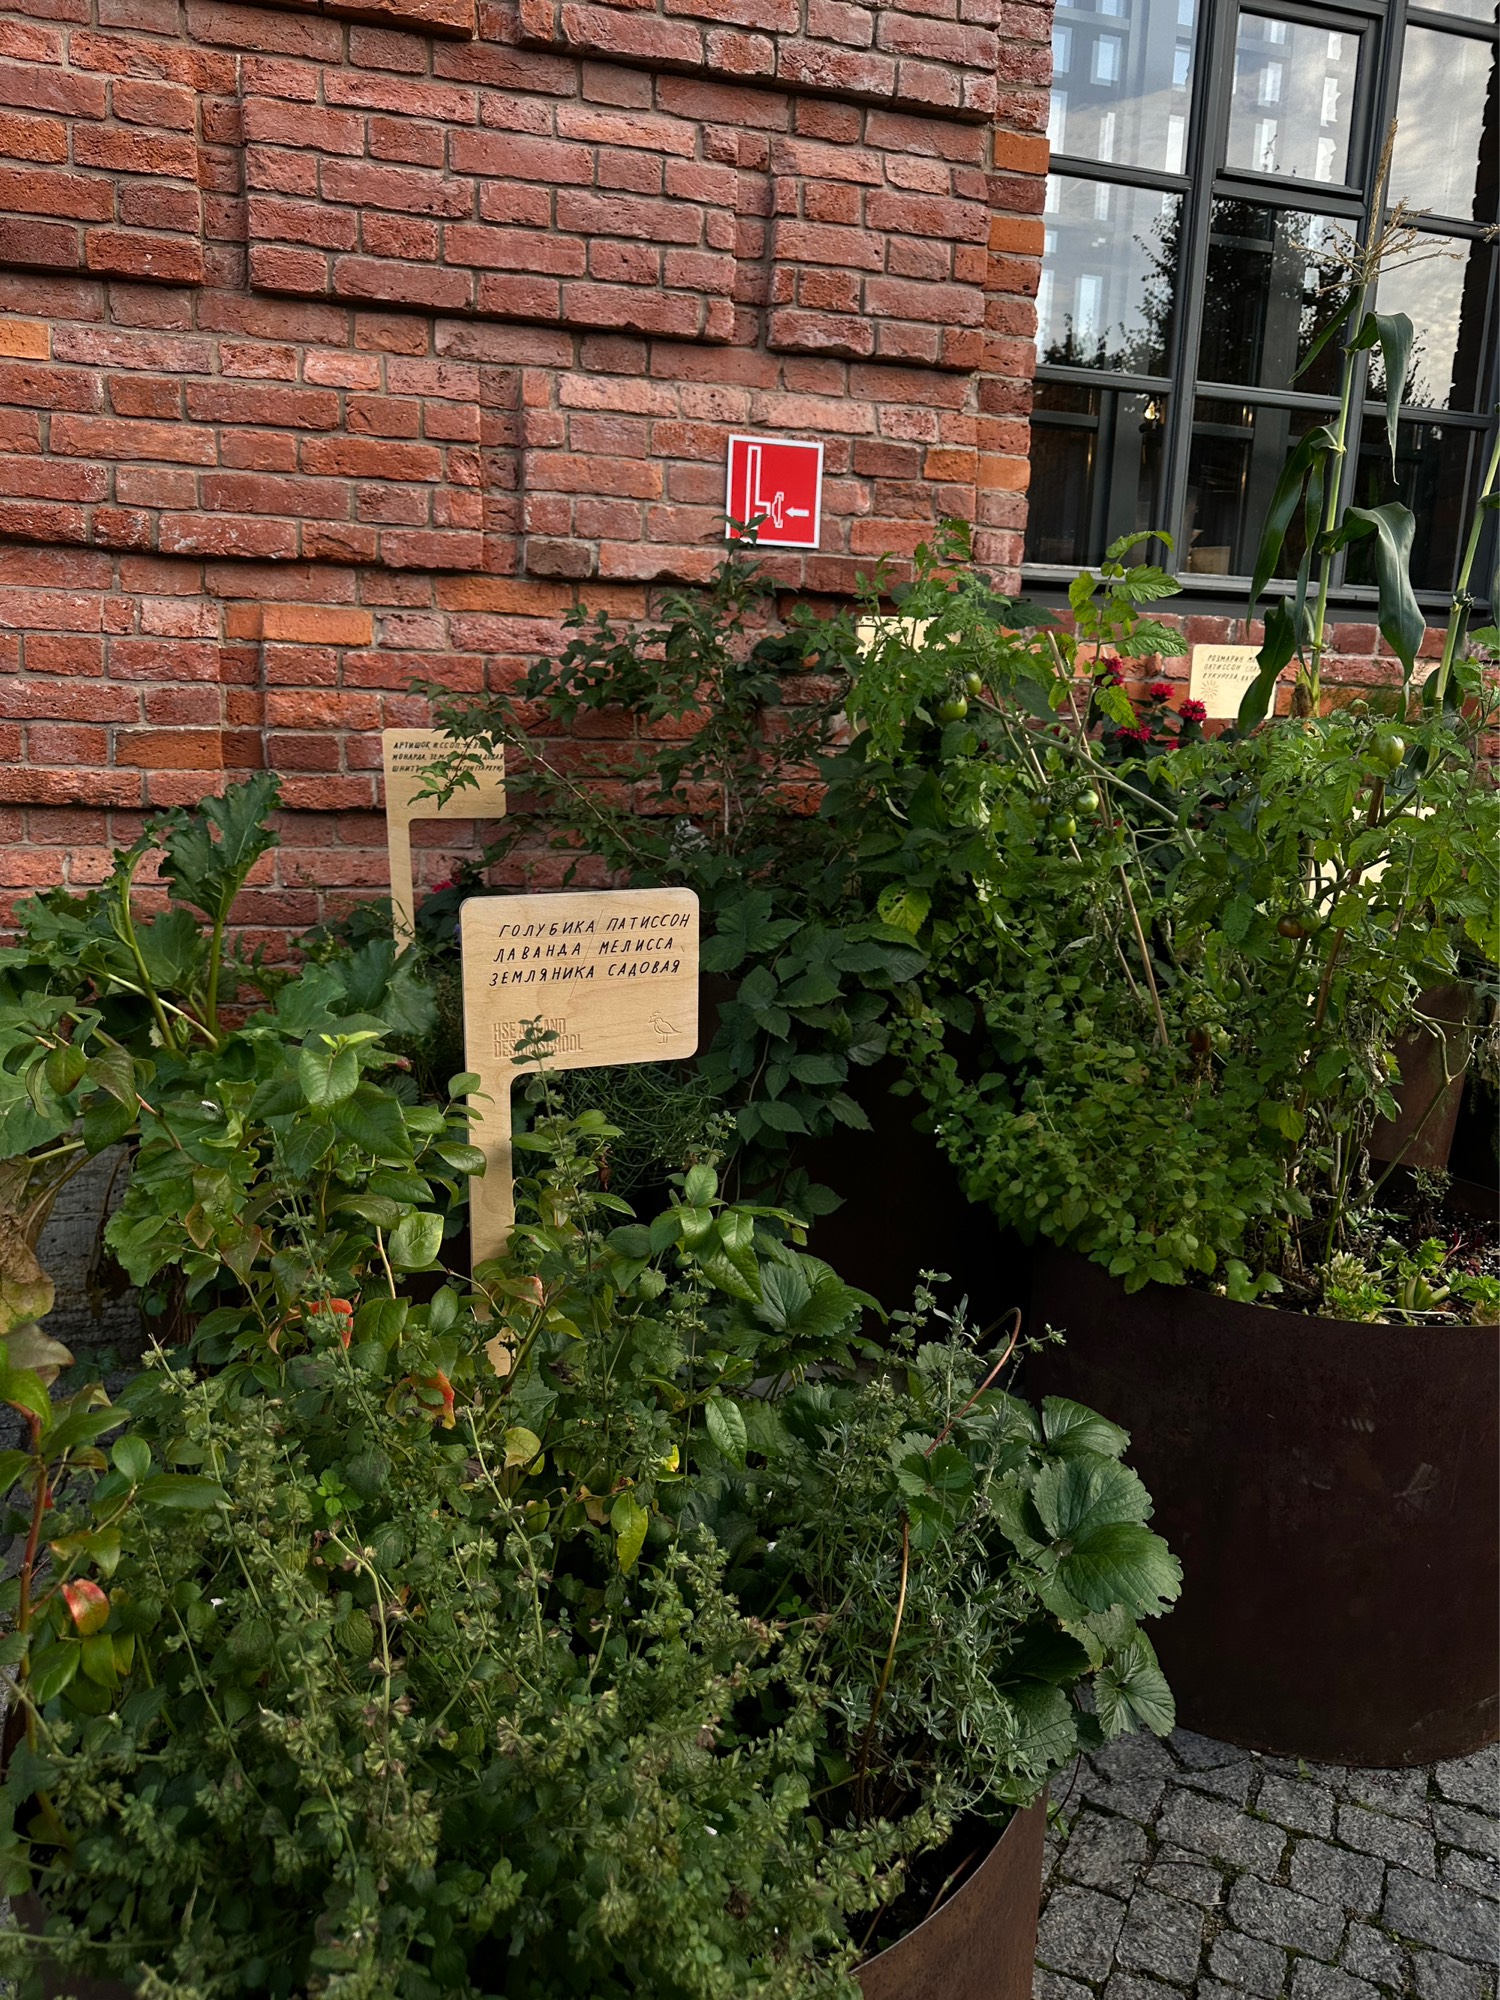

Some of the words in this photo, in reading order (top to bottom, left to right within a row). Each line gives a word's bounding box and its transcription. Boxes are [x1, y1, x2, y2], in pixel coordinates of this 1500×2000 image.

[1204, 663, 1241, 671] ПАТИССОН
[498, 920, 595, 938] ГОЛУБИКА
[606, 913, 691, 932] ПАТИССОН
[493, 942, 581, 963] ЛАВАНДА
[598, 937, 674, 955] МЕЛИССА
[489, 965, 595, 987] ЗЕМЛЯНИКА
[607, 959, 680, 977] САДОВАЯ
[493, 1021, 516, 1041] HSE
